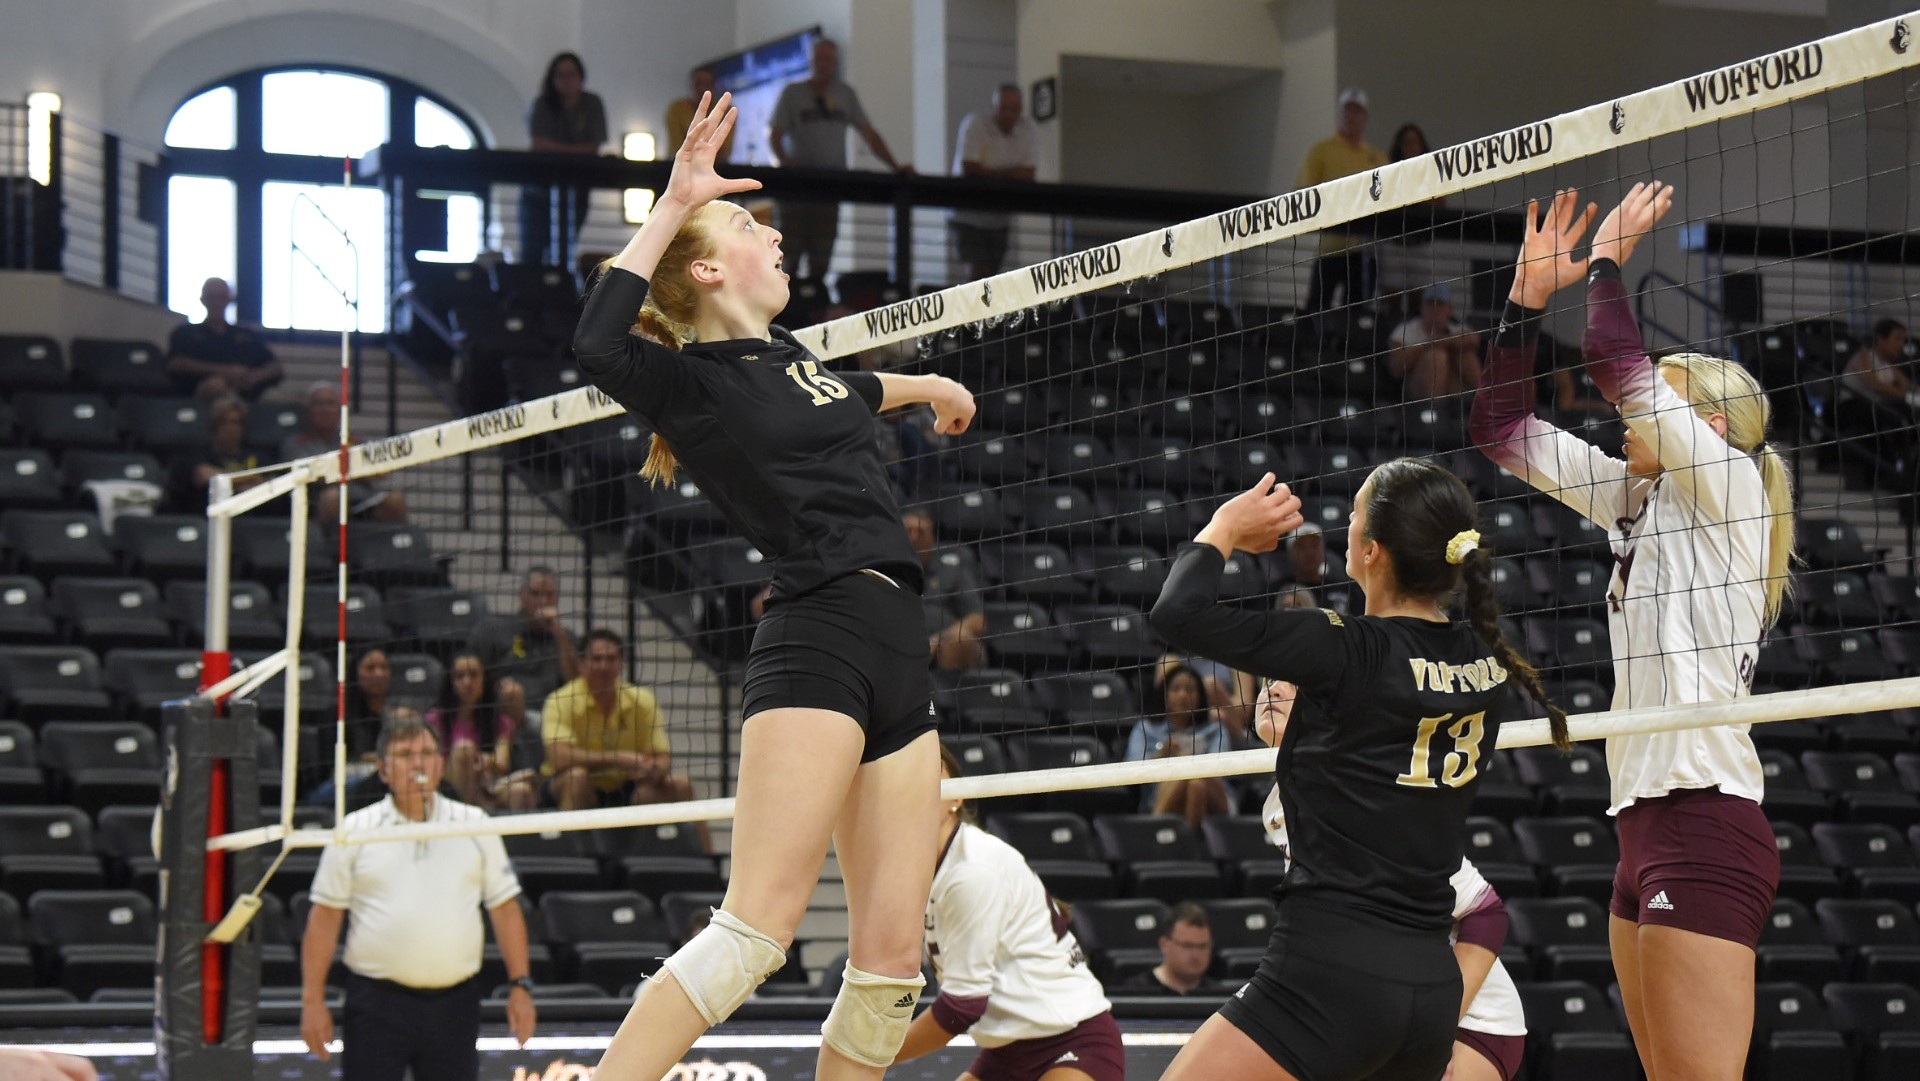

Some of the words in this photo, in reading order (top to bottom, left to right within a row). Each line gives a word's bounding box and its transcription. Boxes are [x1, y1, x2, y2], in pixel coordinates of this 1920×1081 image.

[1683, 43, 1823, 113] WOFFORD
[1433, 122, 1553, 183] WOFFORD
[1218, 188, 1321, 243] WOFFORD
[1030, 244, 1121, 295] WOFFORD
[864, 293, 945, 338] WOFFORD
[785, 360, 849, 407] 15
[1395, 710, 1486, 788] 13
